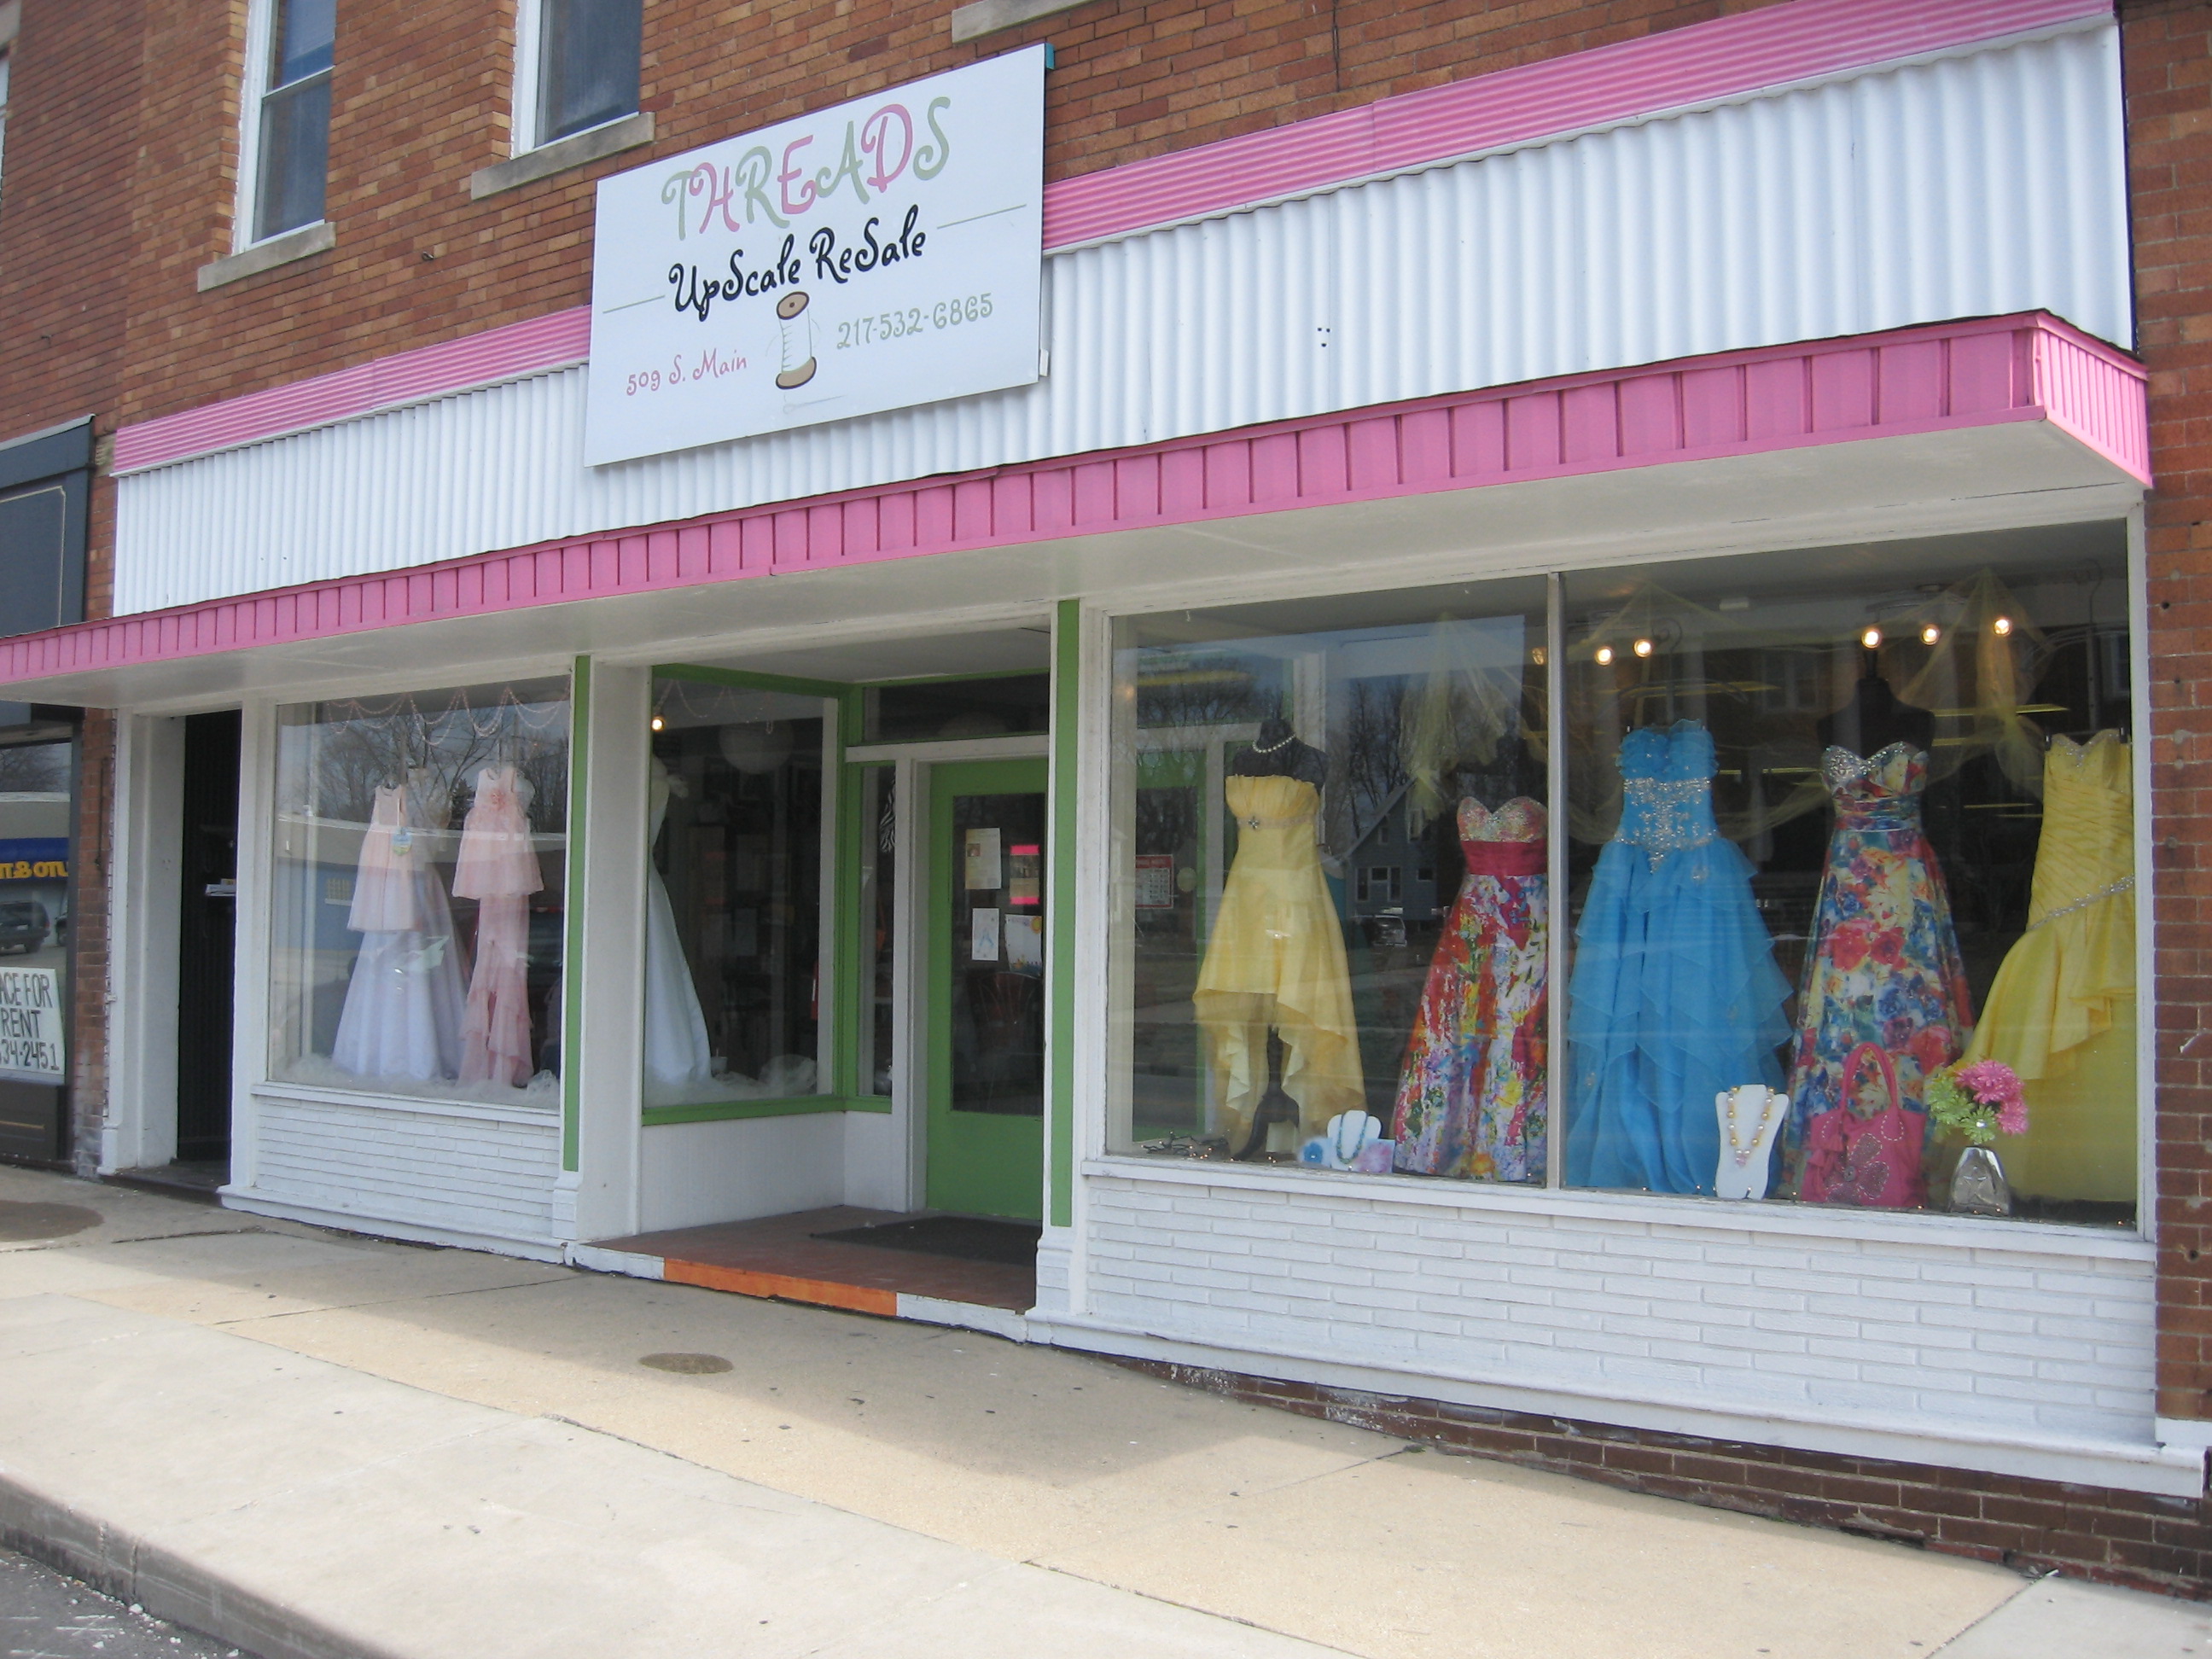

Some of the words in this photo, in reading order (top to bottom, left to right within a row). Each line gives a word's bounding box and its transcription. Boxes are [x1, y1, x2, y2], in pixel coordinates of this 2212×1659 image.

[661, 96, 951, 241] THREADS
[668, 233, 800, 322] UpScale
[809, 205, 926, 283] ReSale
[836, 292, 993, 350] 217-532-6865
[626, 370, 661, 396] 509
[668, 354, 686, 385] S.
[692, 347, 748, 381] Main
[0, 972, 22, 1006] CE
[23, 973, 53, 1008] FOR
[1, 1008, 41, 1039] RENT
[0, 1039, 60, 1071] 34-2451
